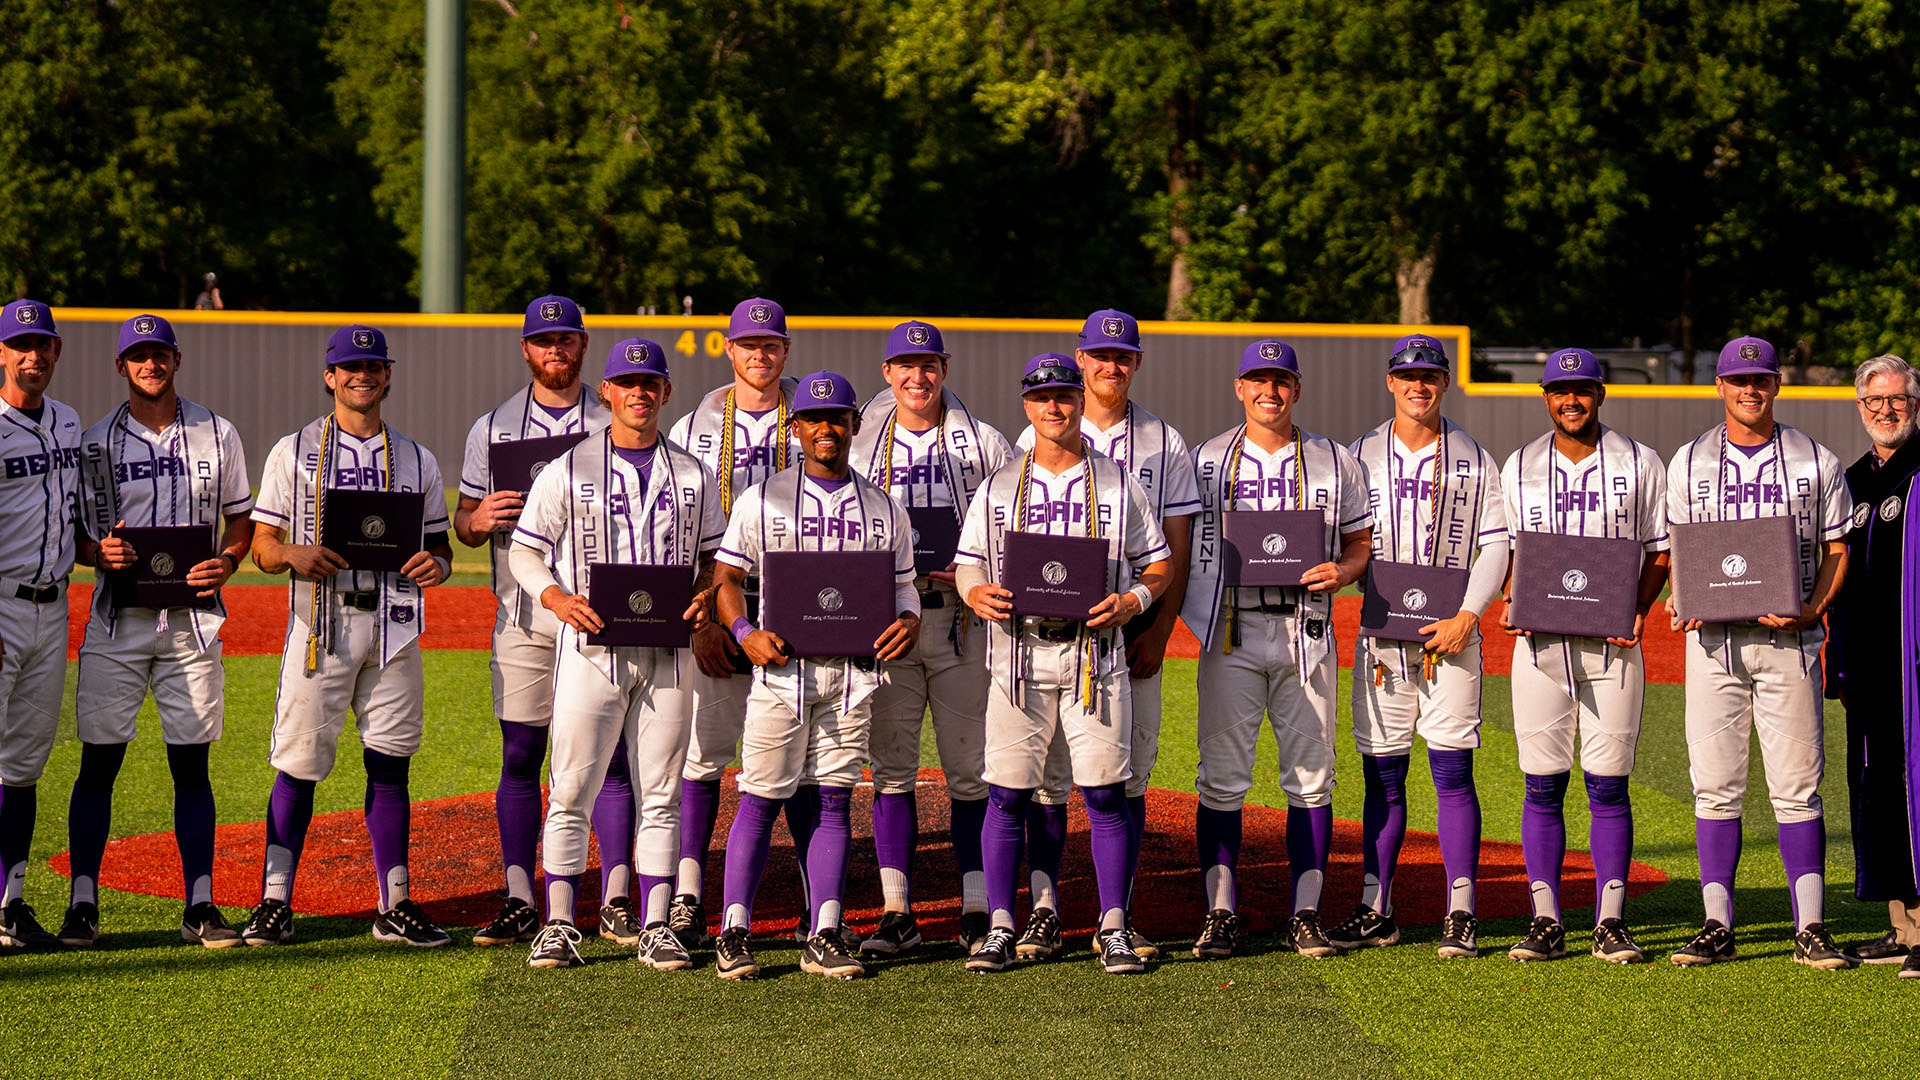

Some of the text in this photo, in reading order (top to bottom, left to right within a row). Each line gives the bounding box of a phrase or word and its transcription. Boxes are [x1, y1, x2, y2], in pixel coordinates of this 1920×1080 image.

[197, 461, 212, 525] ATHL
[1200, 461, 1215, 574] STUDENT
[1613, 477, 1628, 540] ATHL
[1796, 478, 1813, 593] ATHLETE
